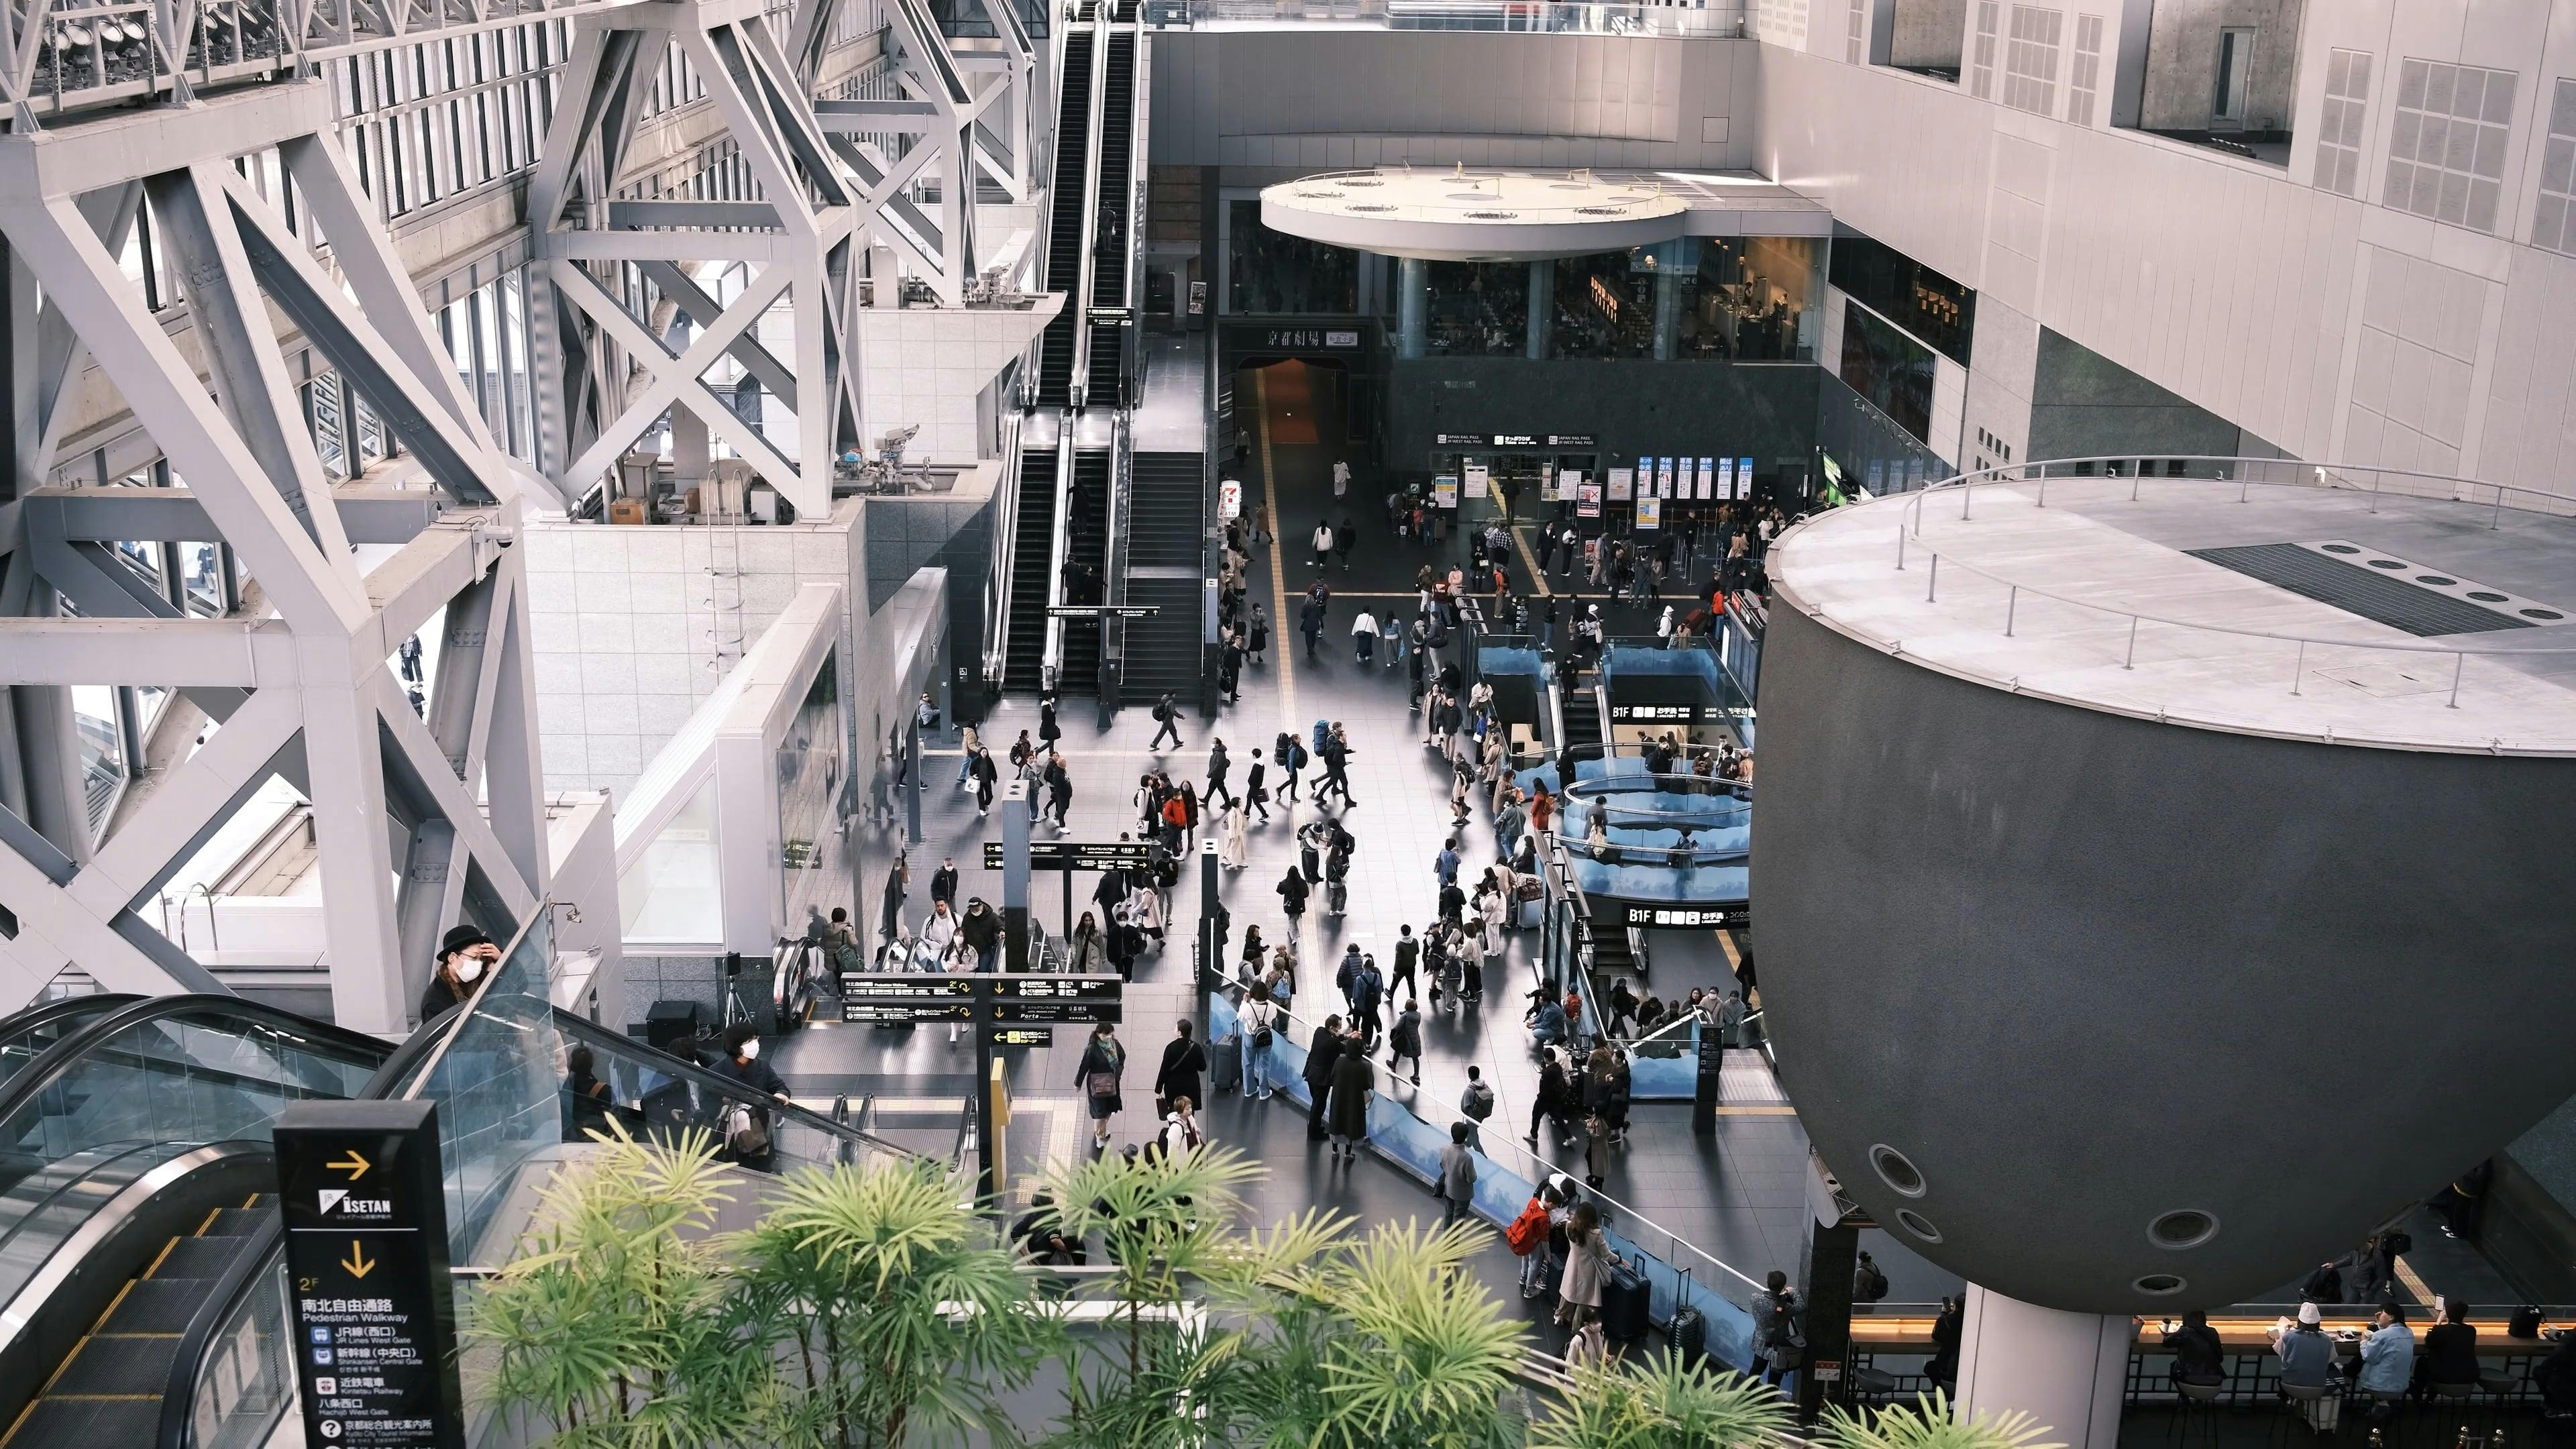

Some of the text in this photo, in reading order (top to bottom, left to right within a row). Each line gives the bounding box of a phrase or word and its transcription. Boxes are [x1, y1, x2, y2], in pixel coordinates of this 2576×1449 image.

[1268, 330, 1319, 346] 京都劇場
[1613, 707, 1629, 718] B1F
[1629, 909, 1651, 923] B1F
[299, 1277, 319, 1291] 2F
[301, 1299, 393, 1313] 南北自由通路
[303, 1313, 408, 1324] Pedestrian Walkway
[340, 1377, 384, 1387] 近鉄電車
[373, 1388, 403, 1396] Railway
[319, 1399, 363, 1409] 八条西口
[345, 1419, 432, 1430] 京都総合観光案内所
